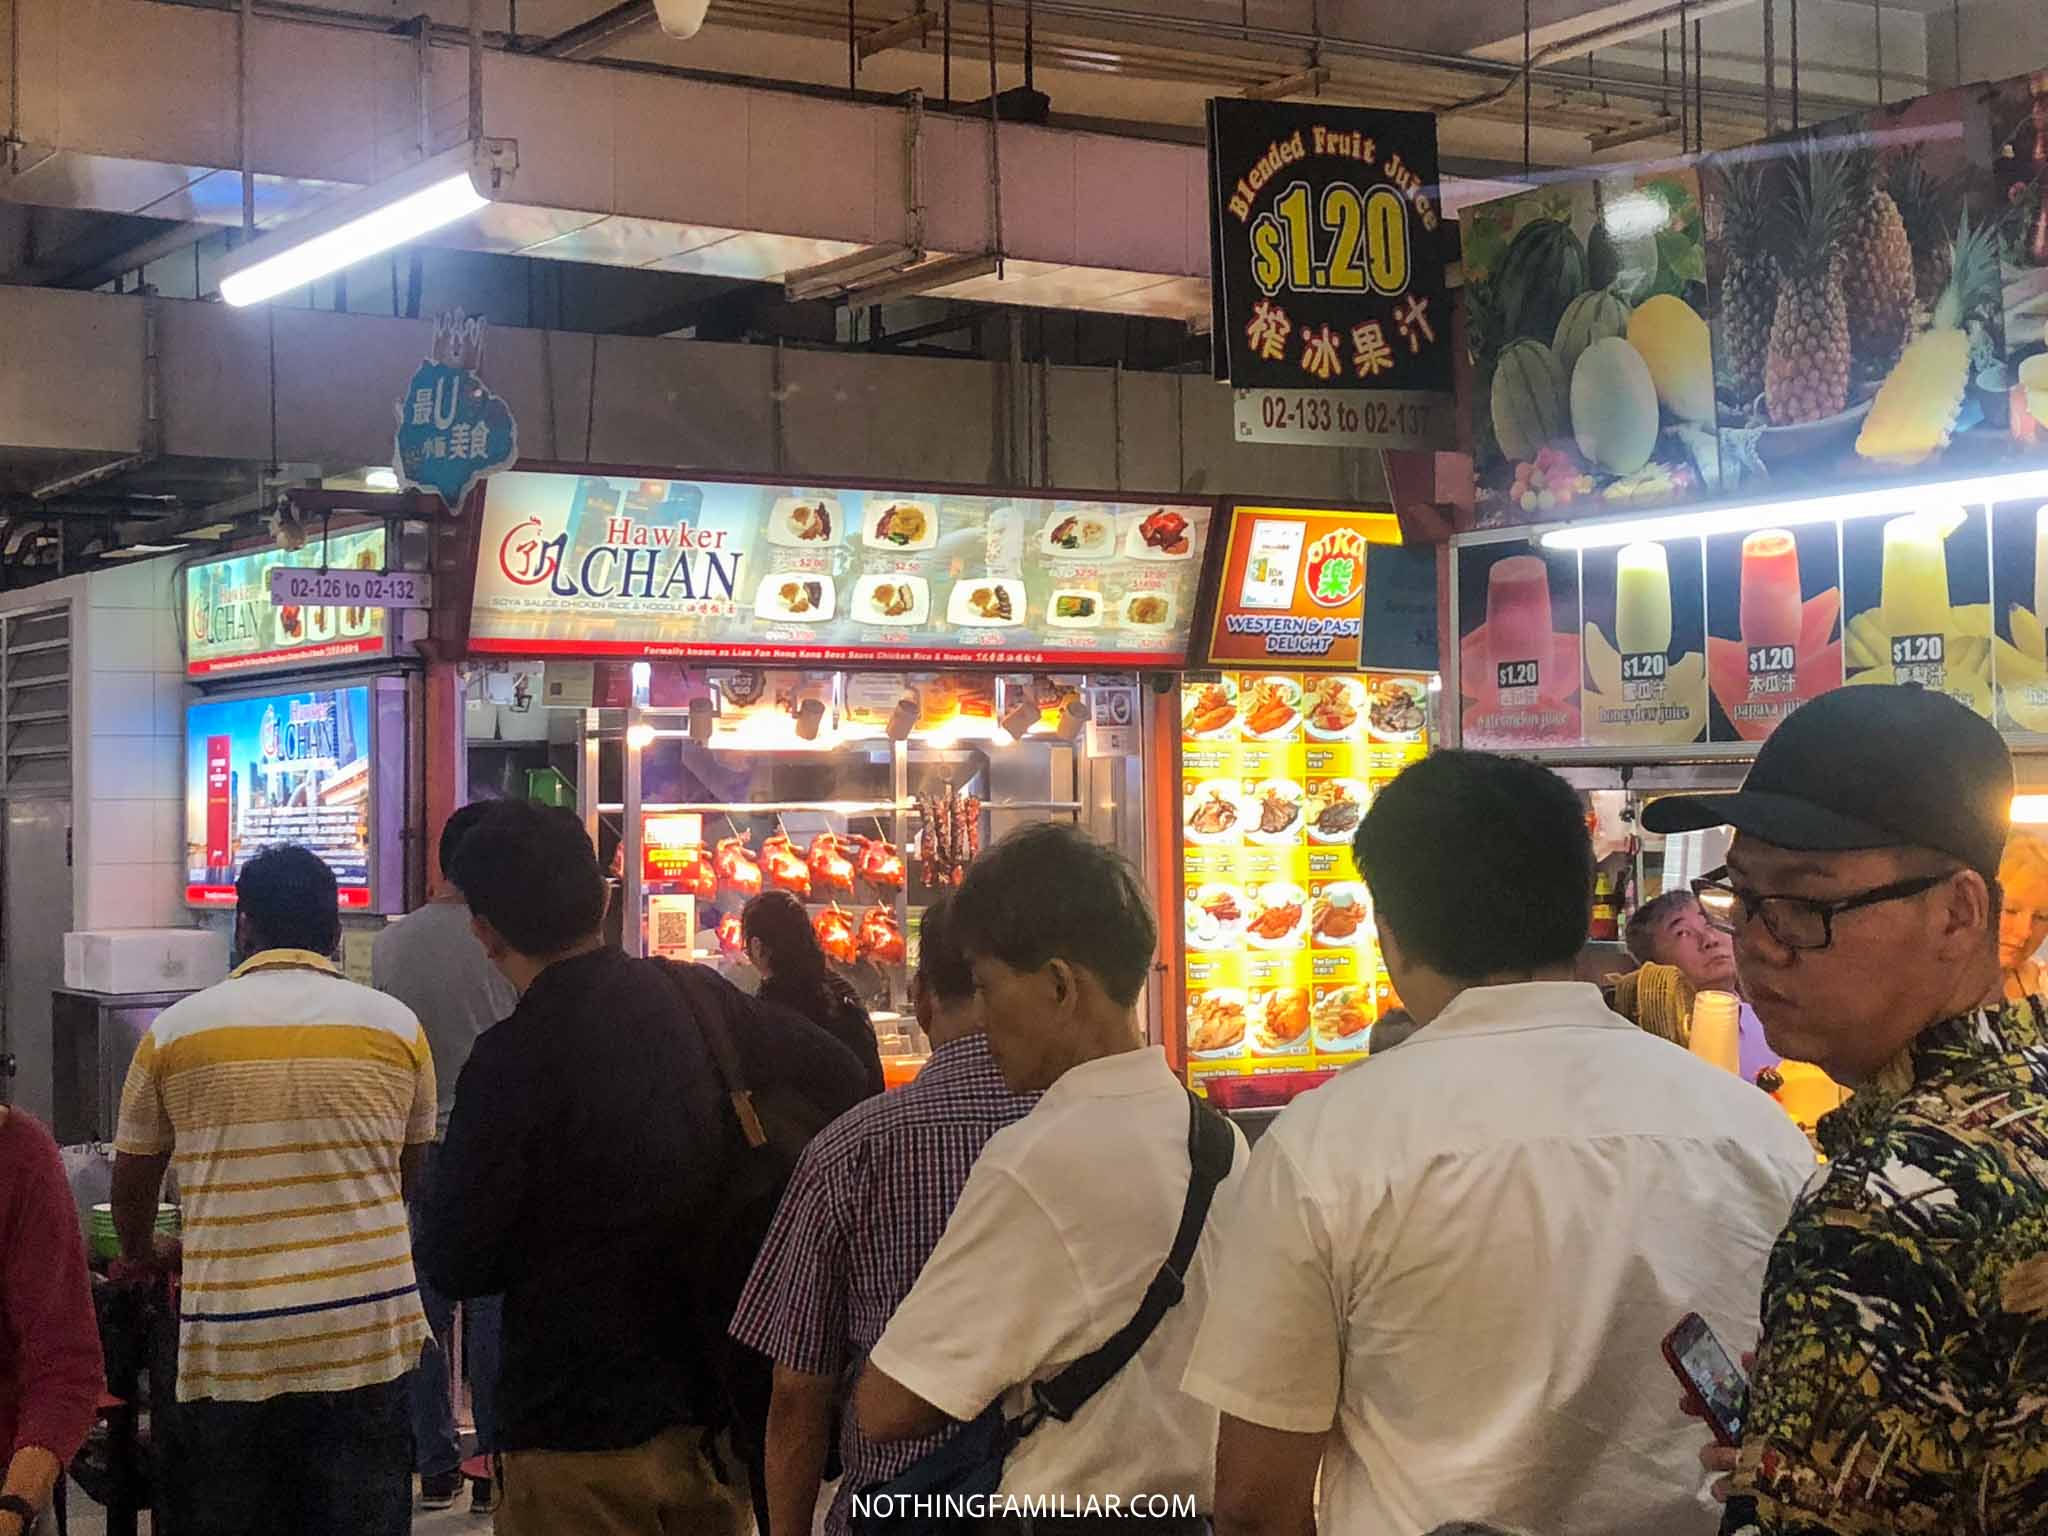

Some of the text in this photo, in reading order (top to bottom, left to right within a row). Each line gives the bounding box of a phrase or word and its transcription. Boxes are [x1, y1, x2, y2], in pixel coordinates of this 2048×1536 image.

[1229, 132, 1305, 222] Blended
[1312, 126, 1376, 164] Fruit
[1252, 183, 1409, 295] $1.20
[1262, 396, 1331, 432] 02-133
[1337, 400, 1359, 433] to
[607, 518, 728, 549] Hawker
[580, 546, 744, 601] CHAN
[290, 578, 415, 600] 02-126 to 02-132
[560, 600, 606, 610] CHICKEN
[1226, 615, 1361, 637] WESTERN & PAST
[1266, 635, 1332, 652] DELIGHT
[1892, 637, 1943, 662] $1.20
[1623, 655, 1664, 678] $1.20
[1749, 647, 1795, 672] $1.20
[1500, 663, 1537, 685] $1.20
[1749, 673, 1797, 694] 木瓜汁
[1782, 695, 1801, 719] jui
